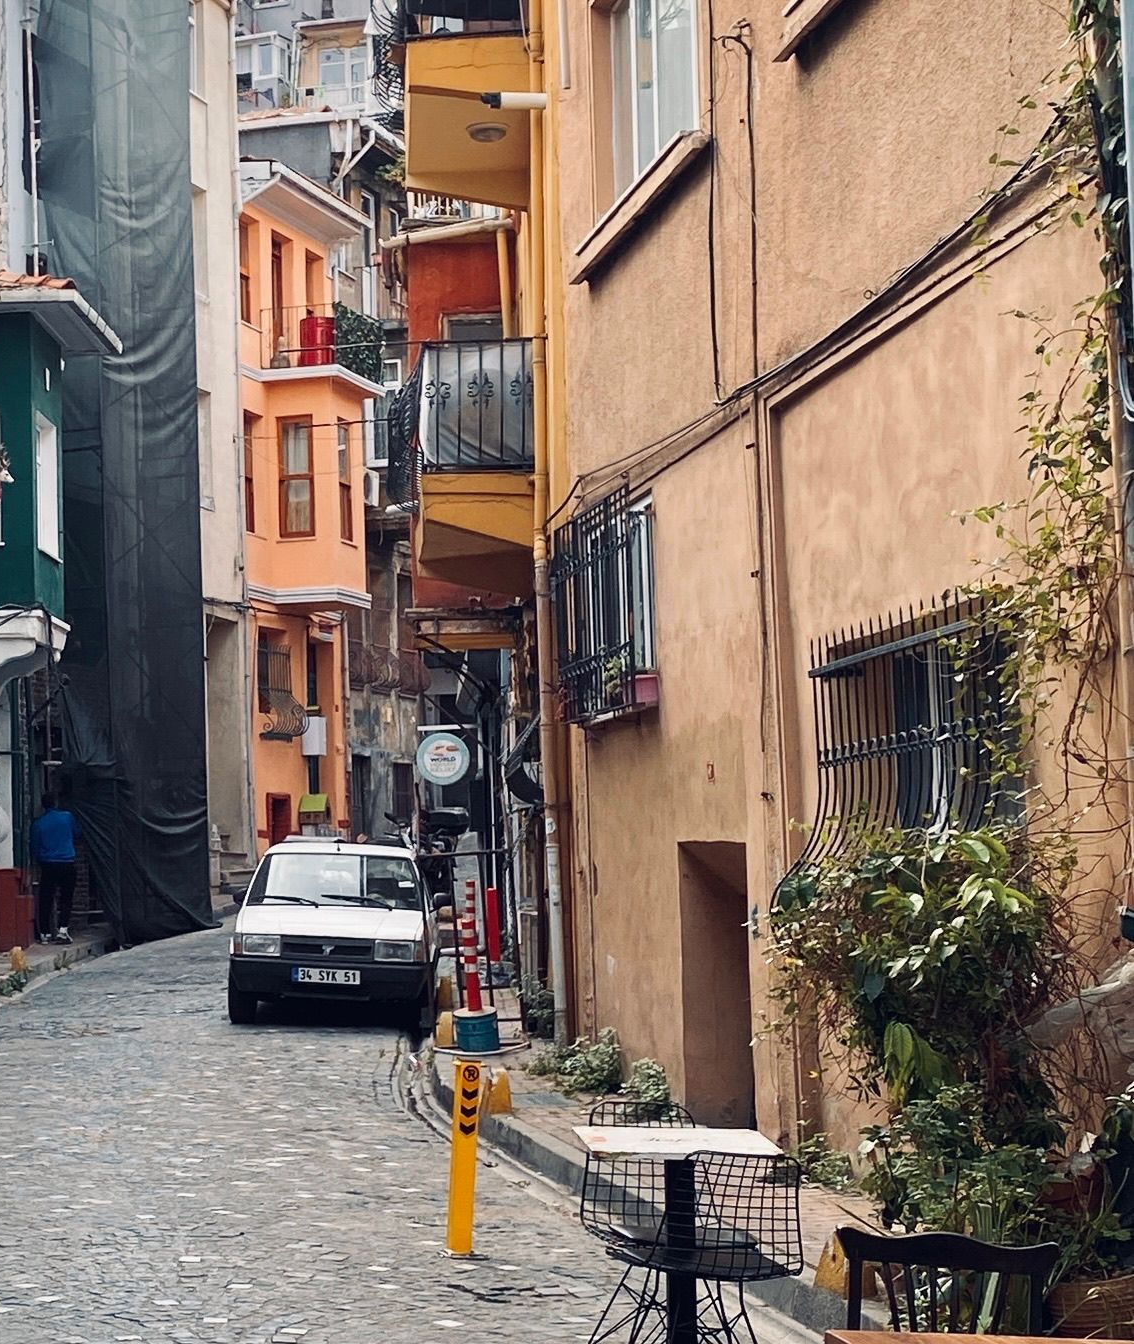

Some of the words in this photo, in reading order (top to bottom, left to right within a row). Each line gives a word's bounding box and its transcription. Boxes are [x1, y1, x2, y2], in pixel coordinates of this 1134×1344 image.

[299, 968, 313, 981] 34
[318, 969, 338, 983] SYK
[344, 971, 357, 983] 51
